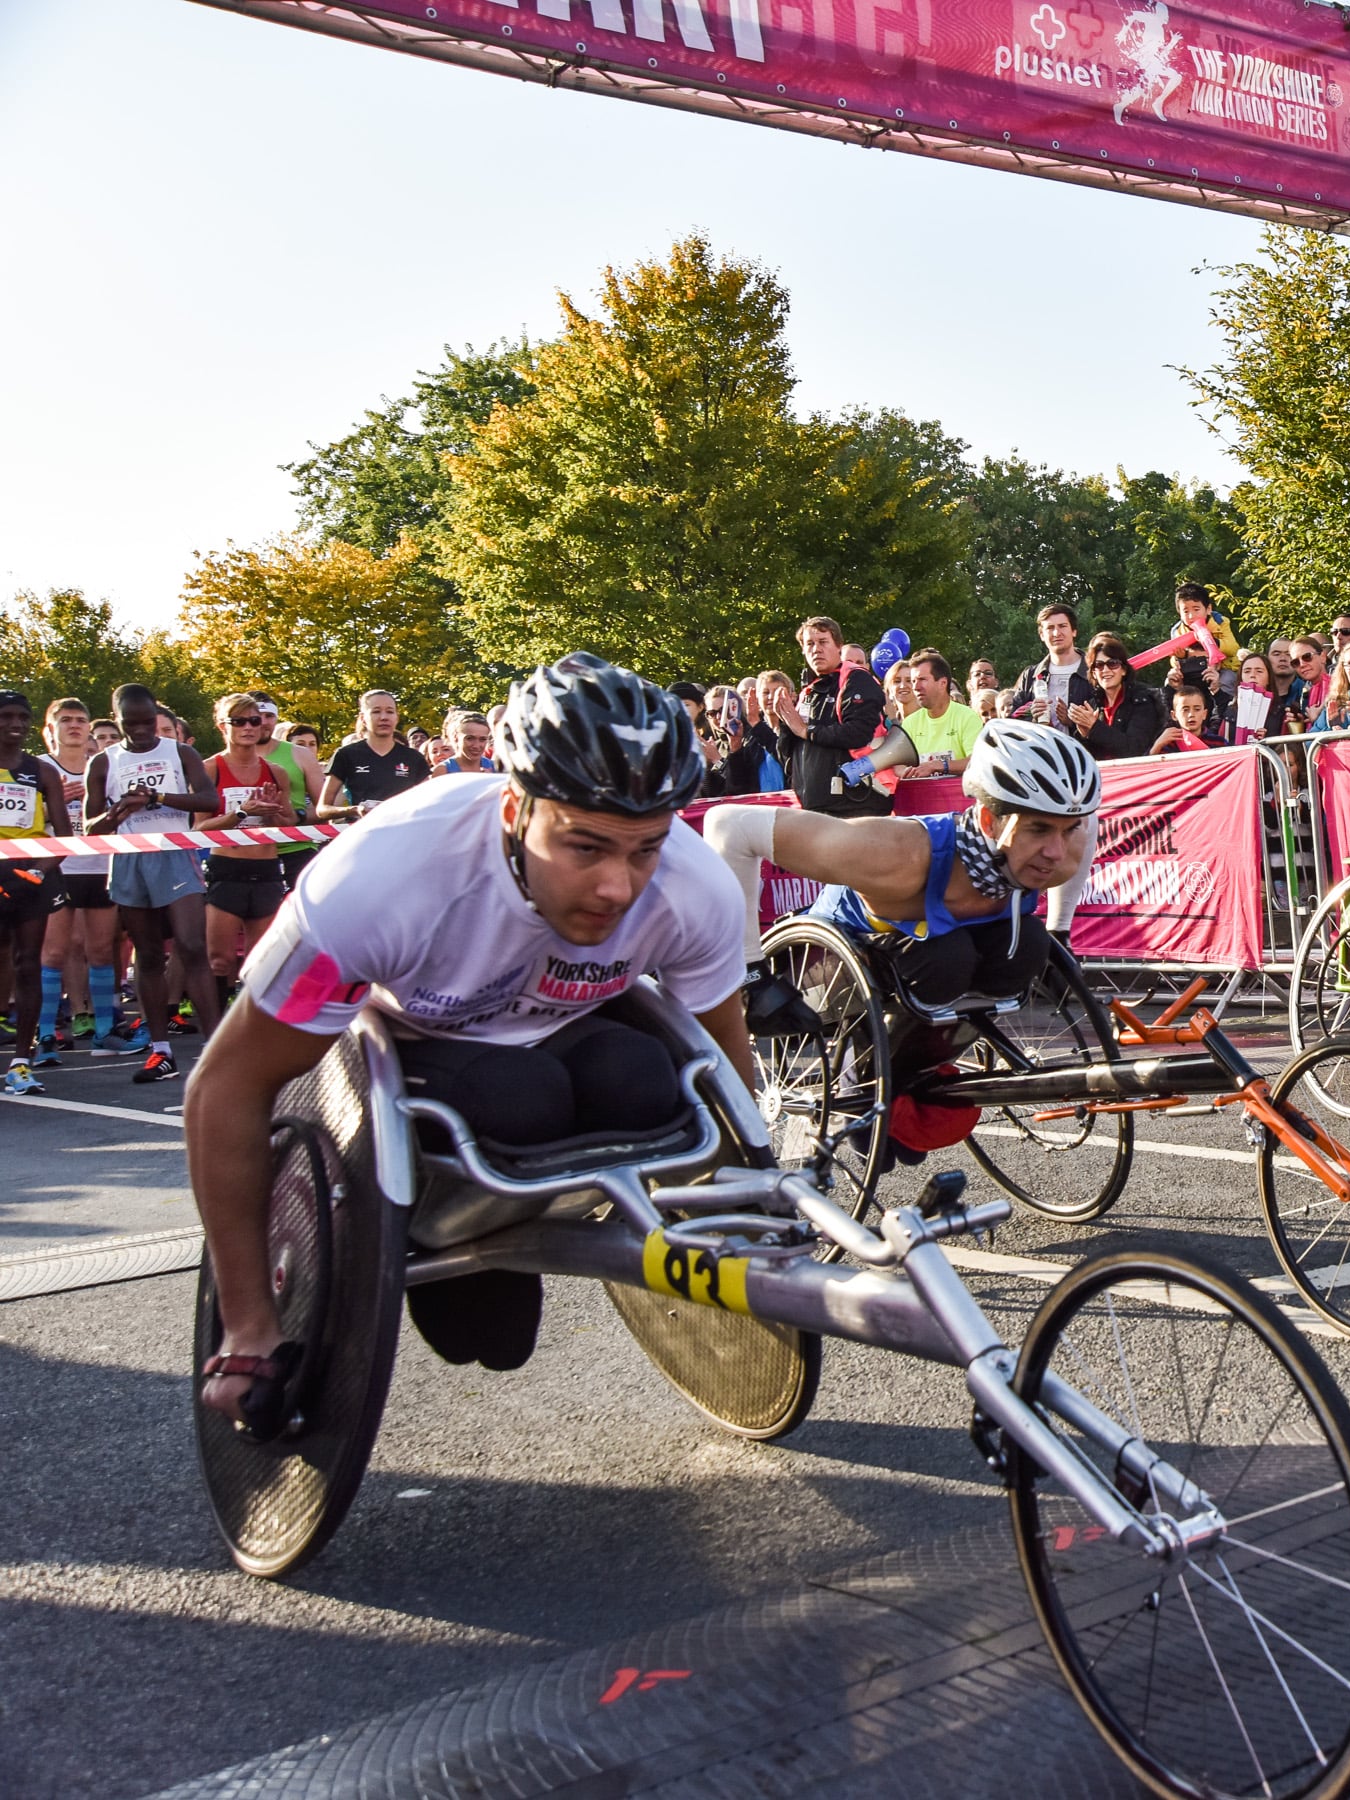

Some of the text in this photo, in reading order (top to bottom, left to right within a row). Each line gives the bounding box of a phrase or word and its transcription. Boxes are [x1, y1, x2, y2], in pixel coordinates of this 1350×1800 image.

[995, 44, 1101, 88] plusnet
[1187, 45, 1227, 84] THE
[1228, 52, 1325, 110] YORKSHIRE
[1190, 80, 1274, 128] MARATHON
[1276, 101, 1328, 141] SERIES
[1094, 811, 1178, 860] RKSHIRE
[771, 877, 825, 914] MARAT
[406, 1000, 437, 1016] Gas
[537, 973, 628, 1001] MARATHON
